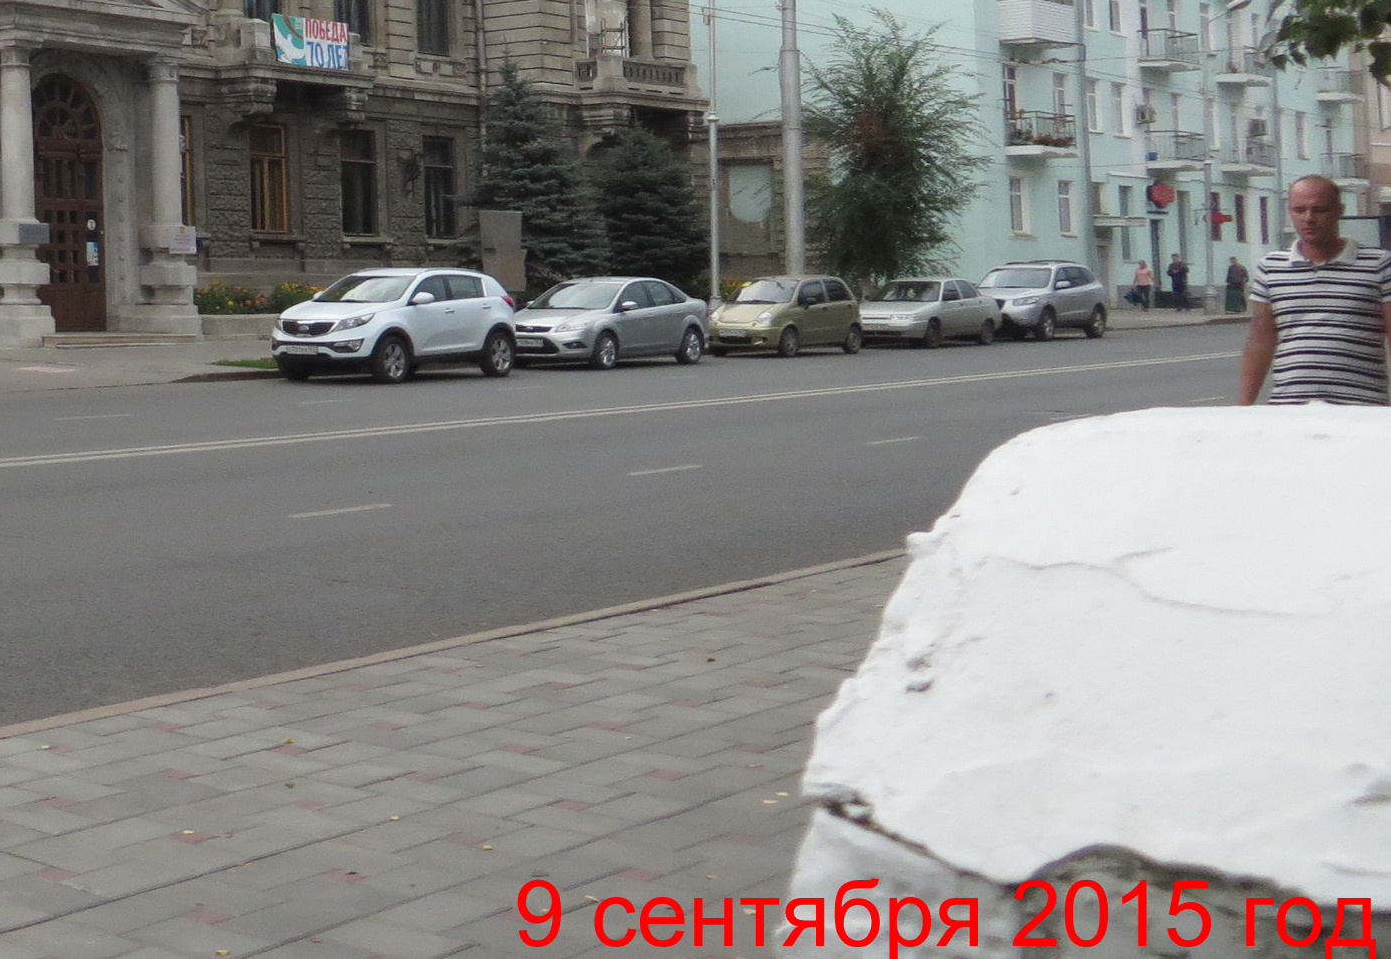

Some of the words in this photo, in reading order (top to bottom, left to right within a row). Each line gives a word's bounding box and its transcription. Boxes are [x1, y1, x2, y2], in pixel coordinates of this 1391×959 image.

[305, 18, 347, 42] ПОБЕДА
[306, 41, 324, 68] 70
[327, 44, 350, 70] ЛЕТ
